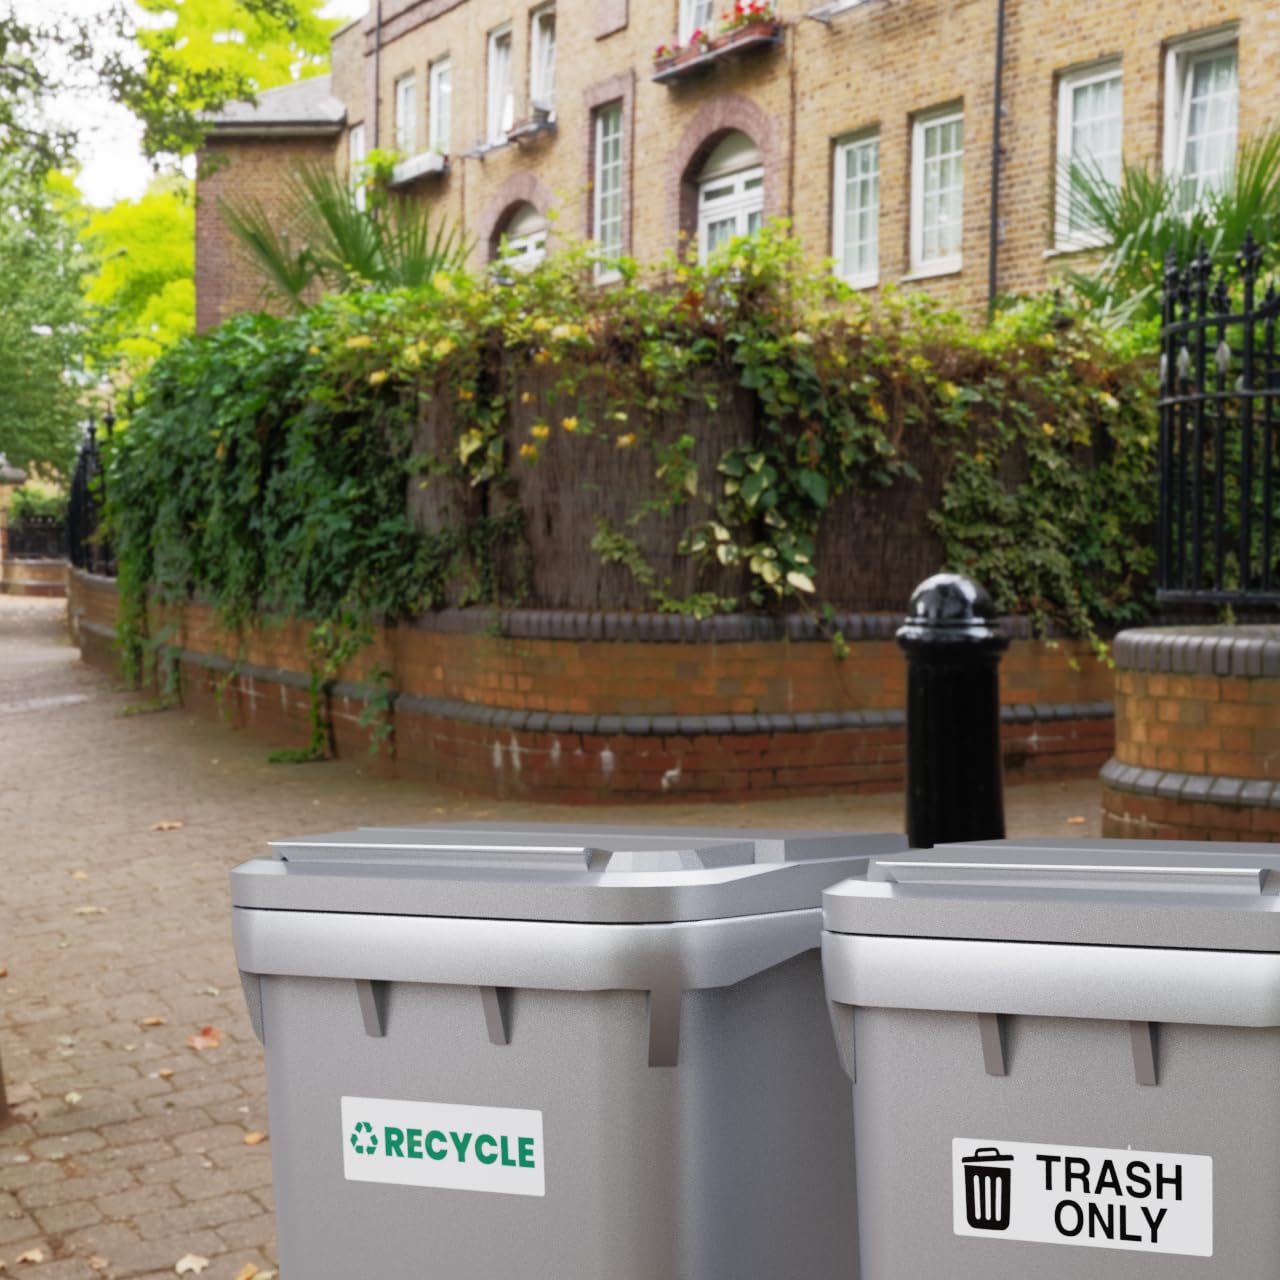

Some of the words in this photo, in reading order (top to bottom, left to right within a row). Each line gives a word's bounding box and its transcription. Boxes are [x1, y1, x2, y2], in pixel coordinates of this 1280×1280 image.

[384, 1126, 535, 1169] RECYCLE
[1036, 1154, 1183, 1201] TRASH
[1054, 1199, 1168, 1244] ONLY
